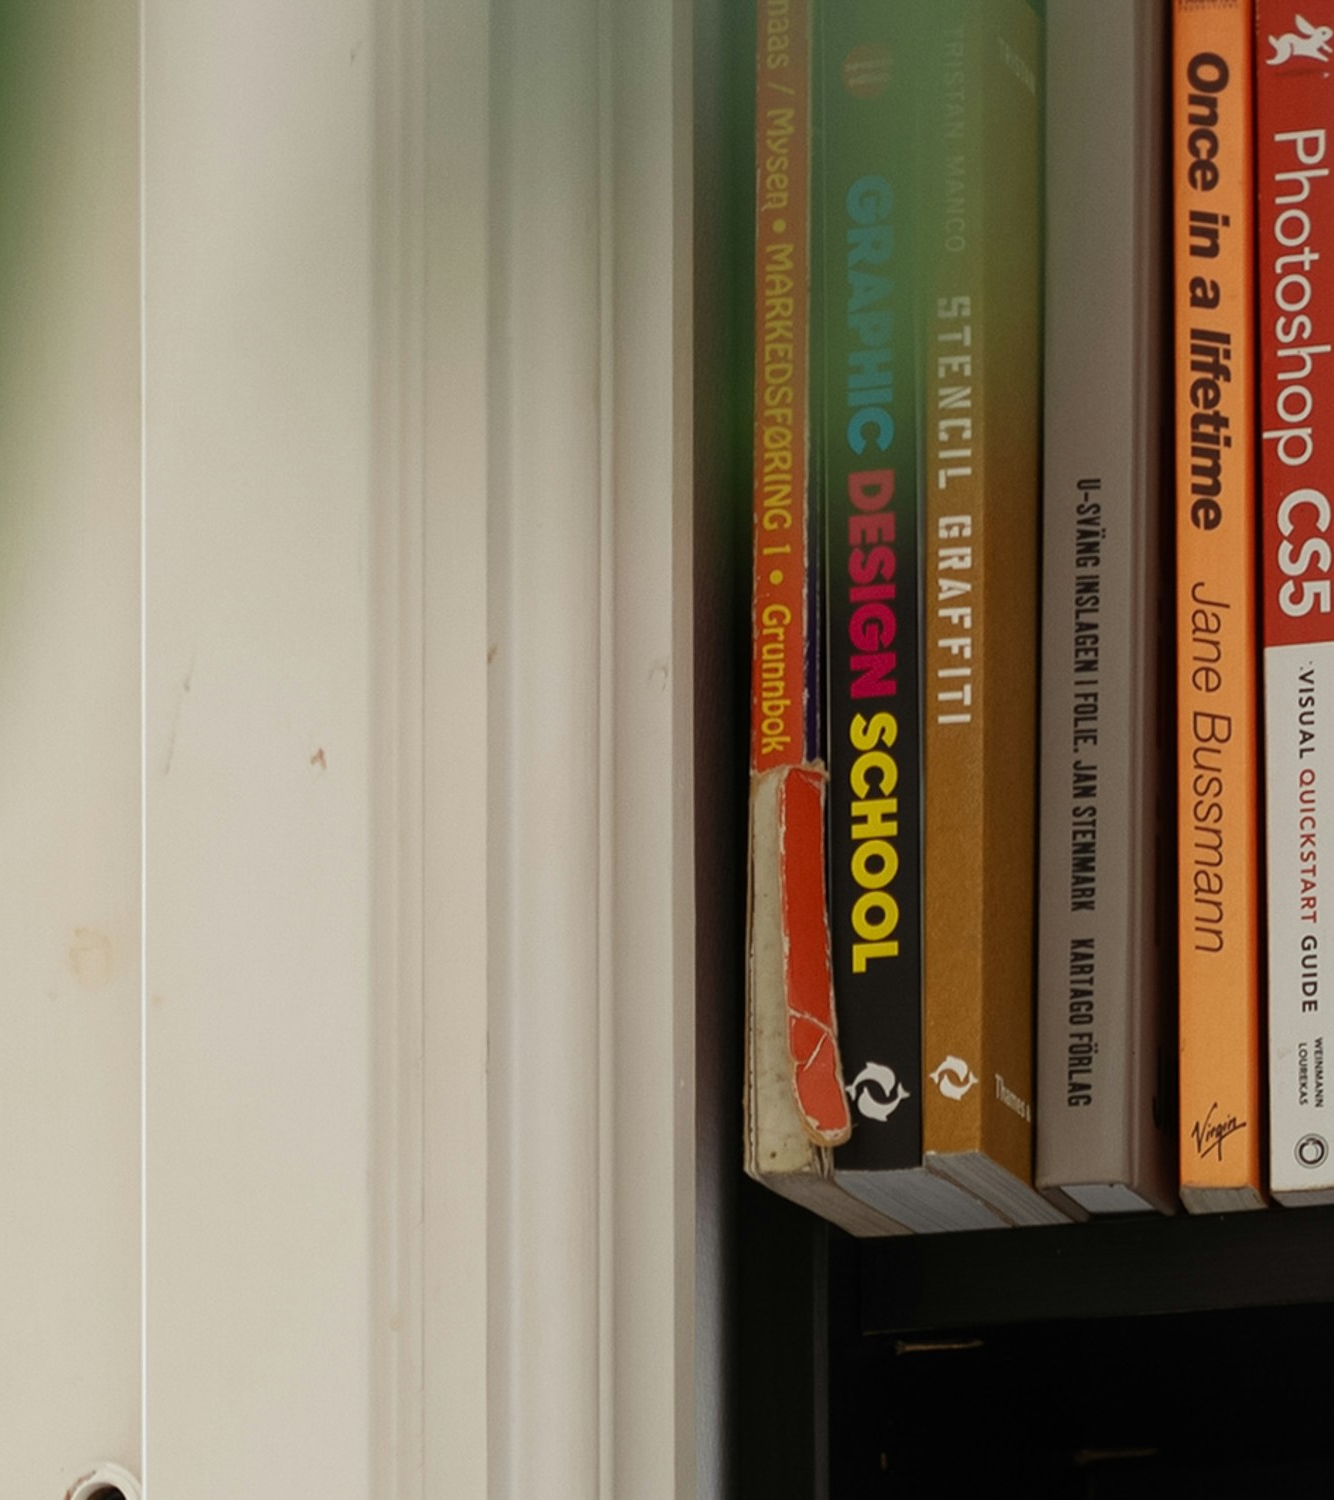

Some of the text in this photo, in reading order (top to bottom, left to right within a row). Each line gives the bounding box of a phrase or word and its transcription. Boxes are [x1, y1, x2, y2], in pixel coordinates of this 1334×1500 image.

[1186, 52, 1230, 191] Once
[1187, 210, 1230, 260] in
[1189, 277, 1223, 310] a
[937, 295, 972, 725] STENCIL GRAFFITI
[1189, 328, 1231, 532] lifetime
[1262, 129, 1332, 618] Photoshop CS5
[846, 176, 898, 974] GRAPHIC DESIGN SCHOOL
[1191, 582, 1232, 953] Jane Bussmann
[1298, 670, 1319, 1014] VISUAL QUICKSTART GUIDE
